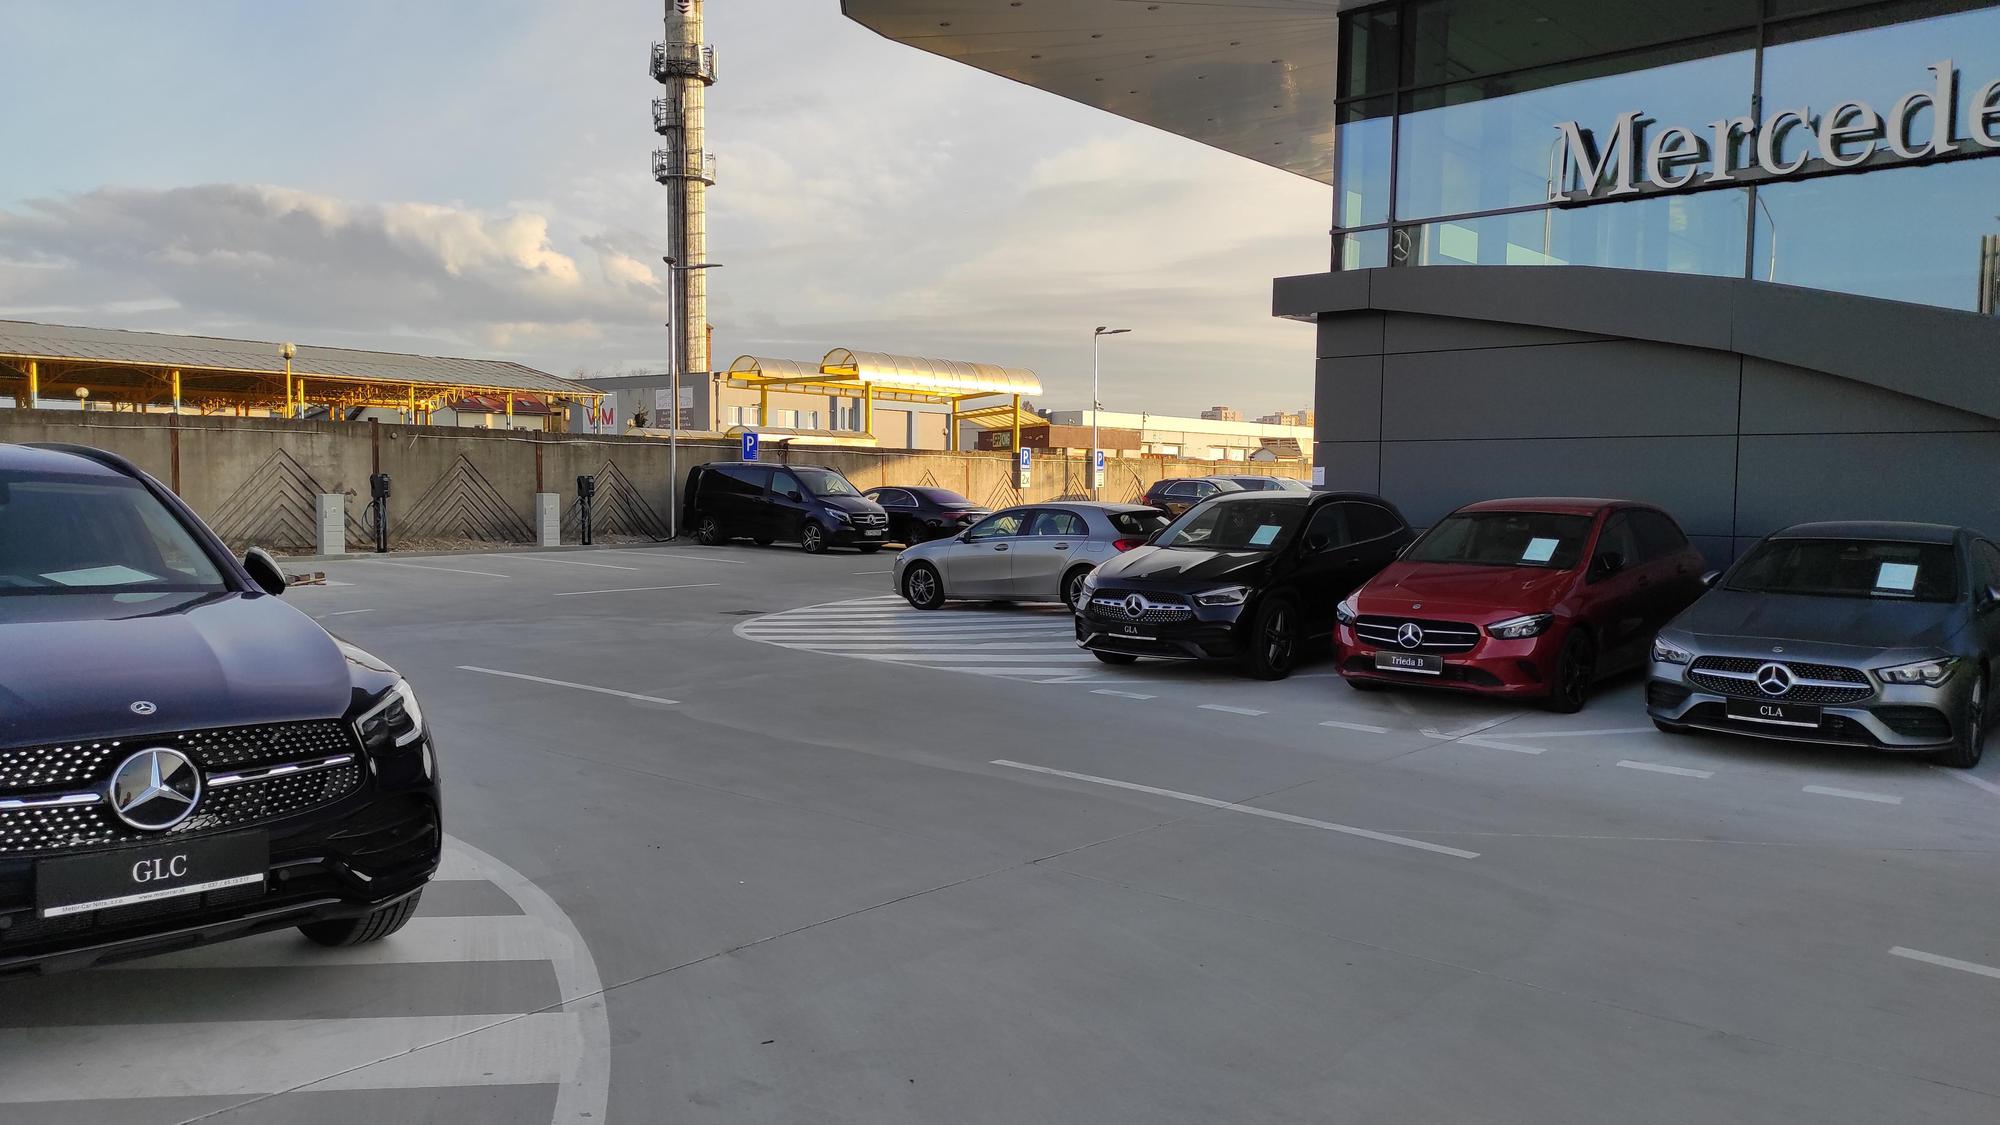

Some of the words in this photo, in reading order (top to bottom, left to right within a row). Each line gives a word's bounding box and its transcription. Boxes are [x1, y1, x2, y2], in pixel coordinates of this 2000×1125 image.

[746, 435, 755, 452] P
[1023, 450, 1029, 464] P
[1124, 625, 1138, 635] GLA
[1391, 656, 1416, 666] Trieda
[1417, 658, 1424, 667] B
[1760, 706, 1783, 717] CLA
[132, 855, 188, 883] GLC
